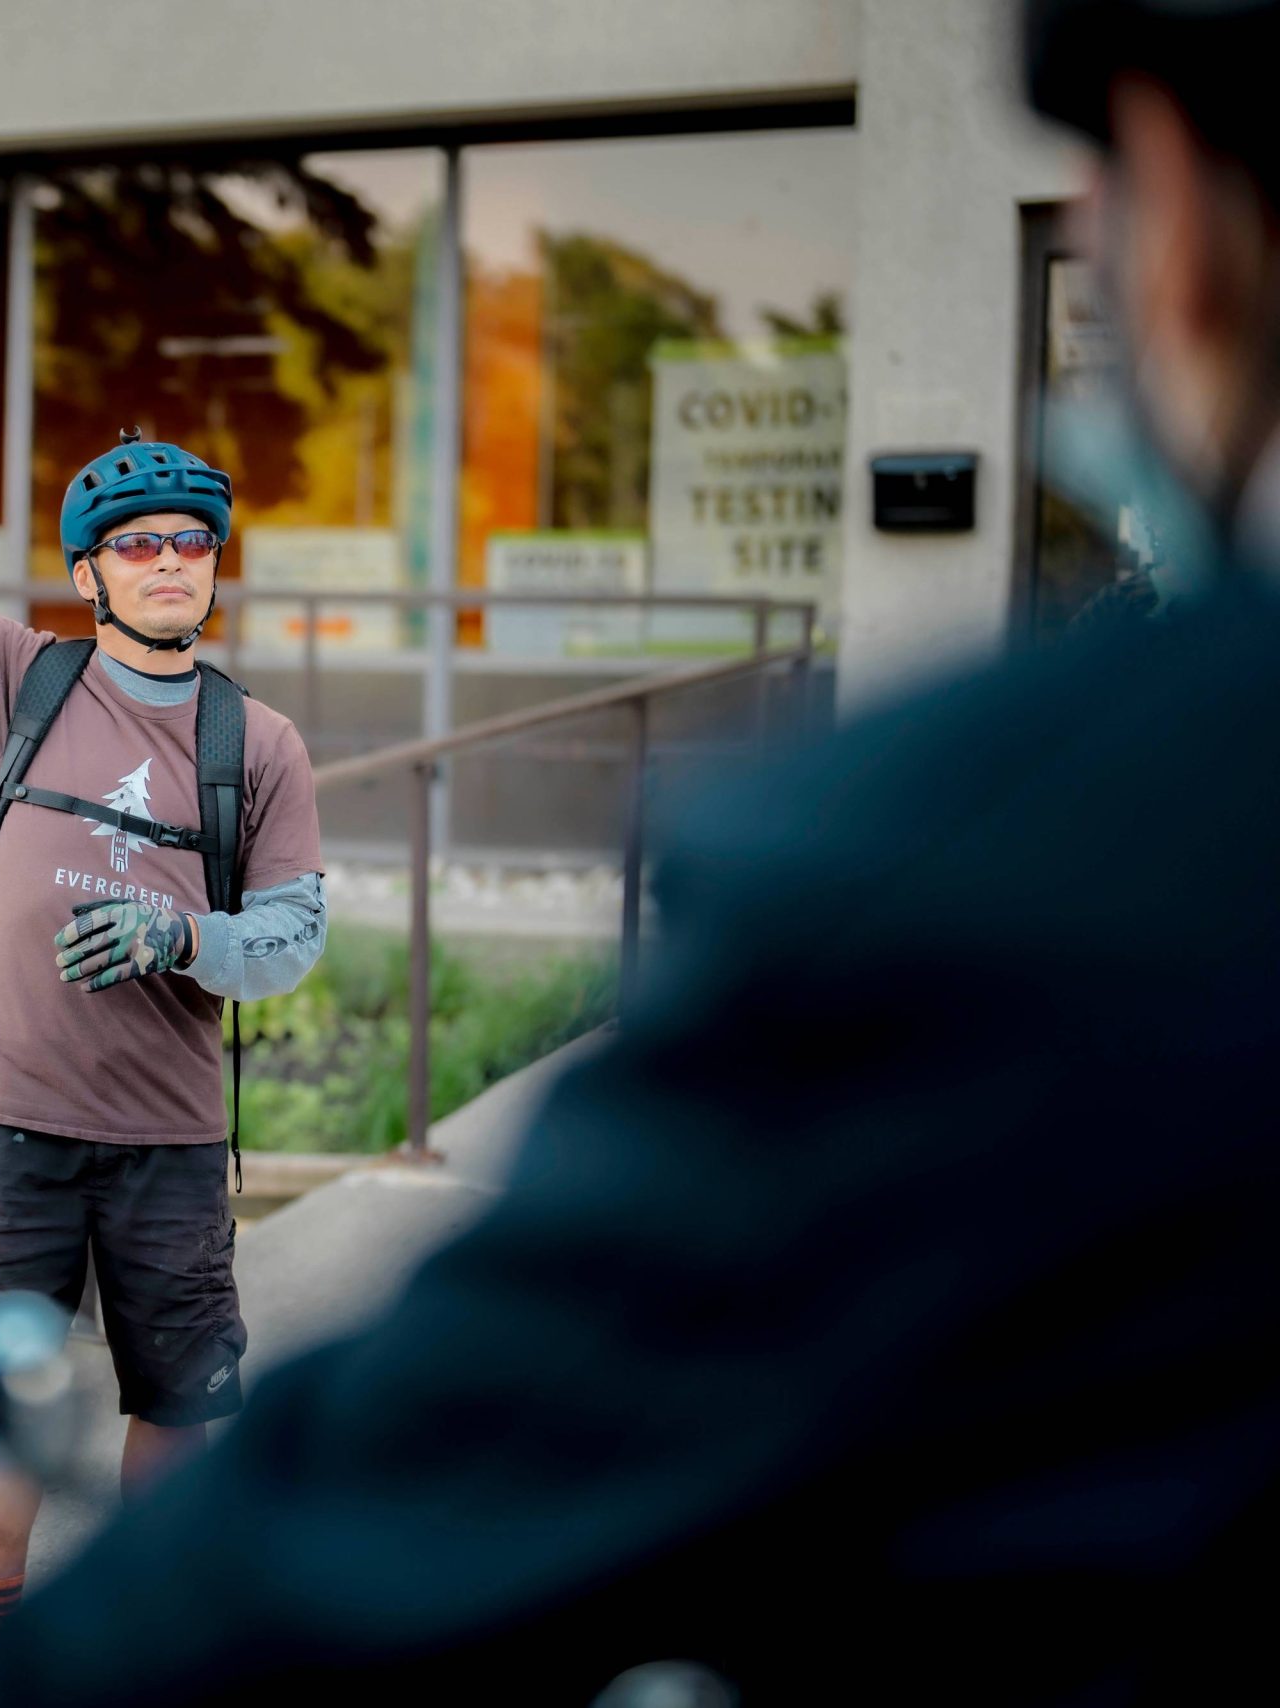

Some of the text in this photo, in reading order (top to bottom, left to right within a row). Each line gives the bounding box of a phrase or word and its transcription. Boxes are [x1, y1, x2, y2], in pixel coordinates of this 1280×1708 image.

[692, 485, 842, 524] TESTIN
[734, 536, 822, 574] SITE
[55, 868, 173, 909] EVERGREEN
[210, 1364, 229, 1386] NIKE
